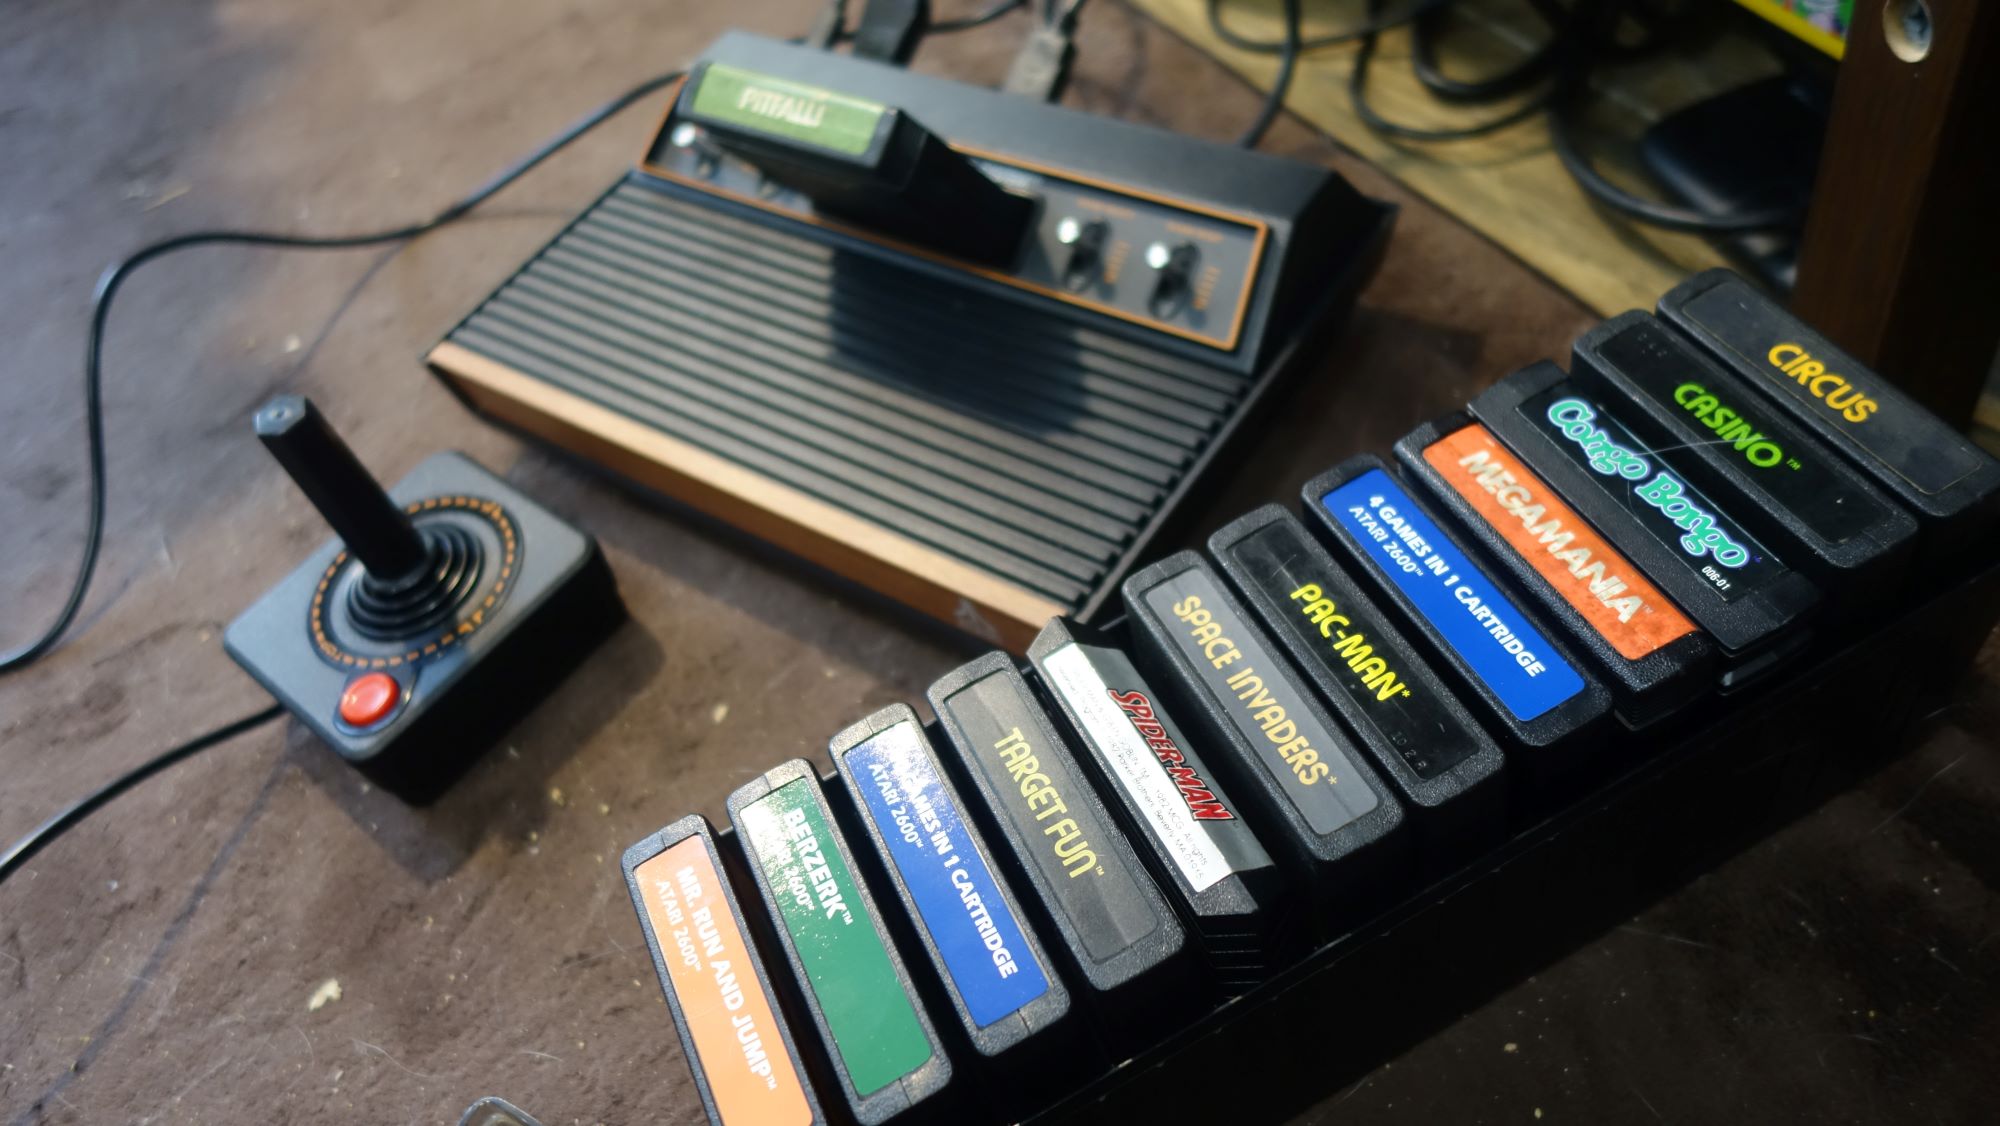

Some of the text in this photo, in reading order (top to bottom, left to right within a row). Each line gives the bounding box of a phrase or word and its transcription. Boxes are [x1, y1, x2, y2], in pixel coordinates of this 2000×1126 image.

[1768, 343, 1878, 423] CIRCUS
[1348, 505, 1388, 546] ATARI
[1548, 398, 1749, 568] Congo Bongo
[1370, 494, 1547, 678] 4 GAMES IN 1 CARTRIDGE
[1701, 565, 1731, 591] 006-01
[1173, 595, 1242, 670] SPACE
[867, 763, 899, 808] ATARI
[994, 727, 1067, 821] TARGET
[1107, 687, 1239, 822] SPIDER-MAN
[656, 880, 683, 927] ATARI
[676, 865, 704, 909] MR.
[692, 904, 724, 956] RUN
[711, 954, 745, 1013] AND
[929, 830, 954, 856] IN
[943, 855, 957, 869] 1
[951, 868, 1019, 979] CARTRIDGE
